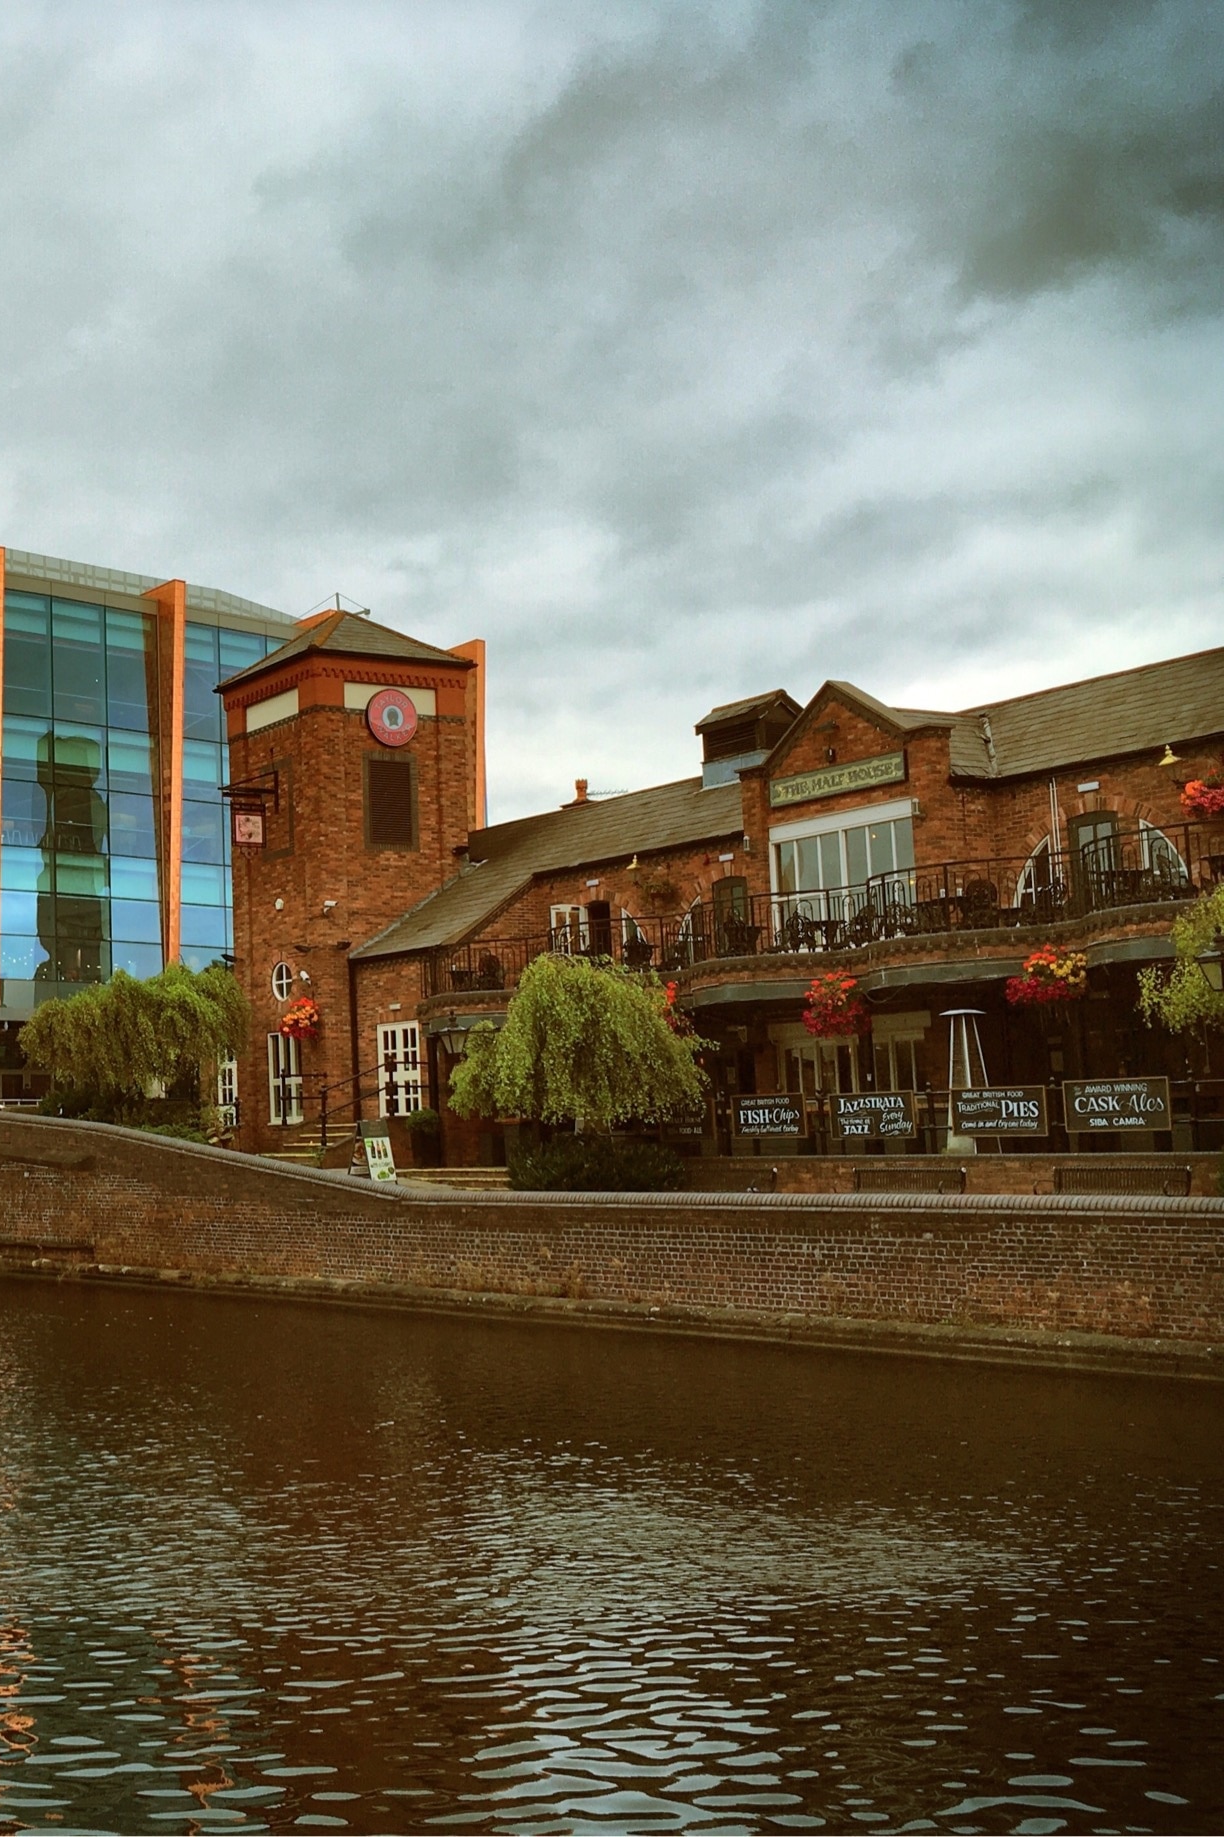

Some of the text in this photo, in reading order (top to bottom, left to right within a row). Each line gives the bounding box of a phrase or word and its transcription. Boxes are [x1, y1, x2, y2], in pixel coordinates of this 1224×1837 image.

[375, 694, 408, 708] TAYLOR
[378, 723, 413, 741] WALKER
[785, 780, 809, 798] THE
[848, 761, 893, 784] HOUSE
[1085, 1085, 1112, 1094] AWARD
[1113, 1083, 1148, 1093] WINNING
[756, 1098, 775, 1106] BRITISH
[775, 1097, 790, 1105] FOOD
[1074, 1093, 1165, 1113] CASK Ales
[739, 1107, 800, 1124] FISH Chips
[956, 1100, 1039, 1118] TRADITIONAL PIES
[882, 1111, 904, 1122] Every
[1112, 1117, 1146, 1126] CAMRA
[843, 1124, 871, 1135] JAZZ
[879, 1120, 913, 1135] Sunday
